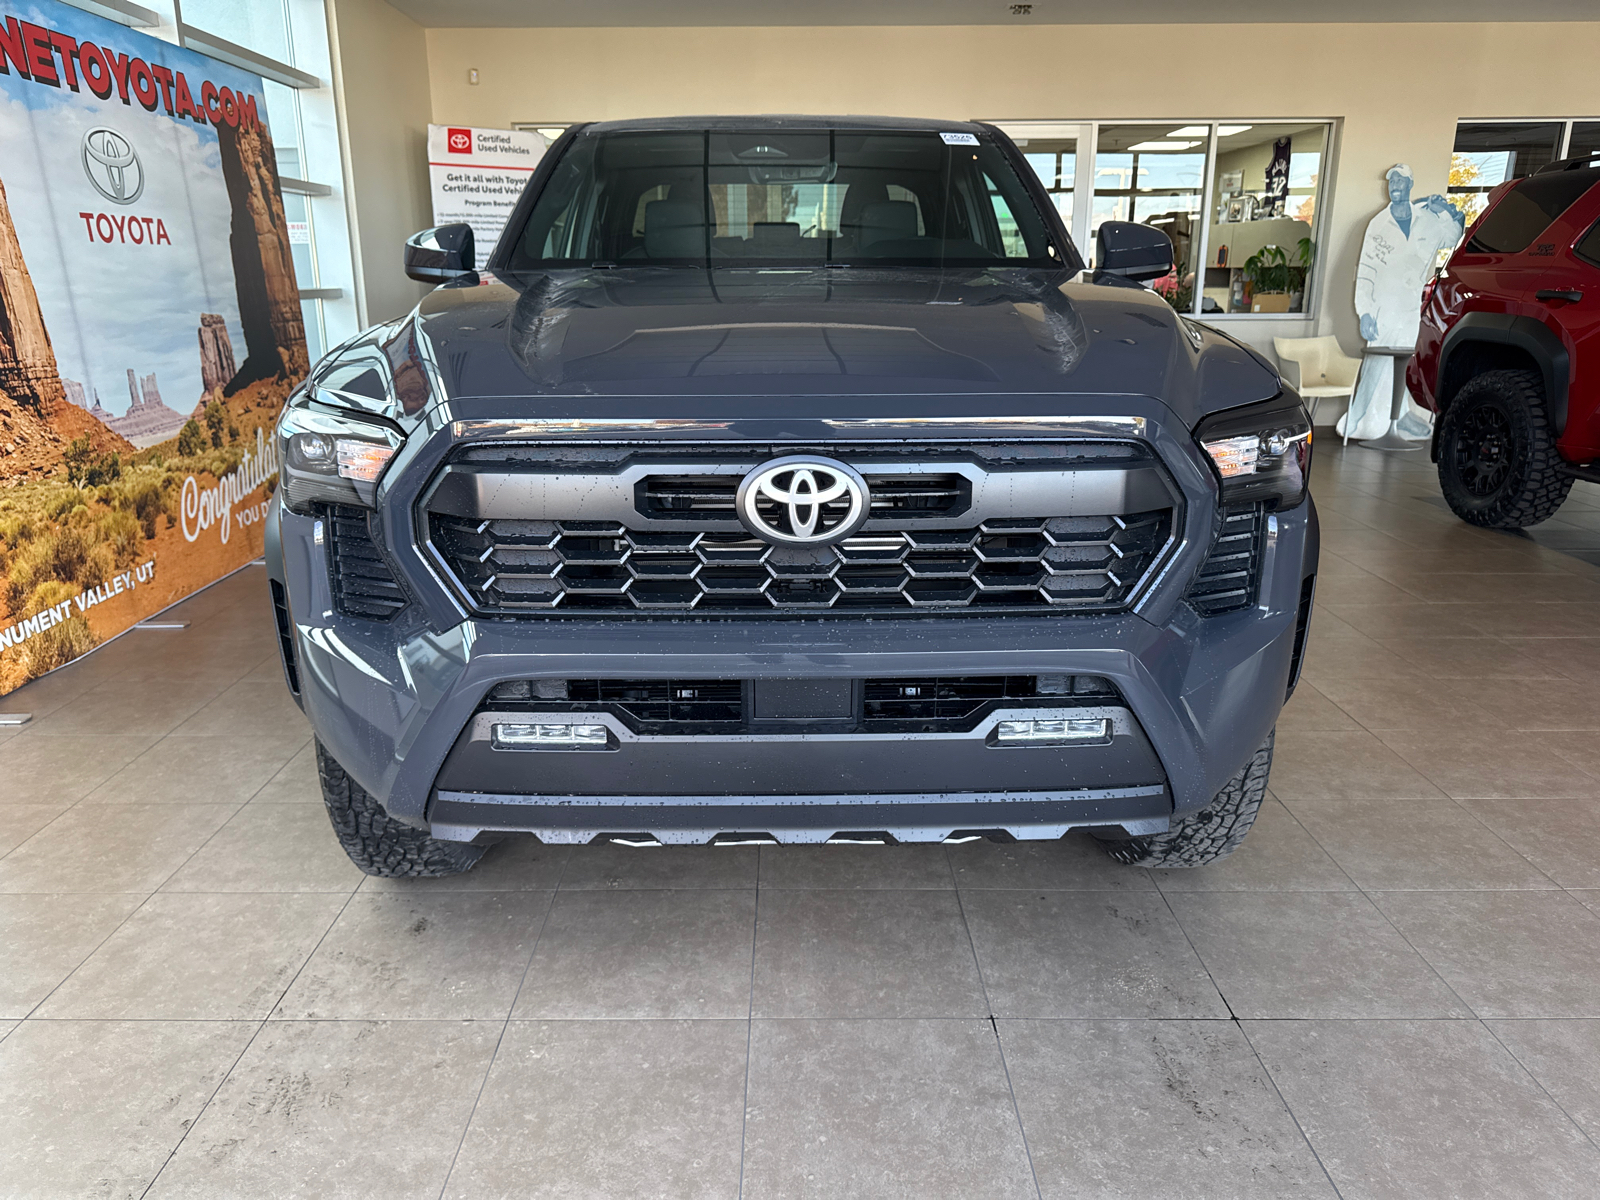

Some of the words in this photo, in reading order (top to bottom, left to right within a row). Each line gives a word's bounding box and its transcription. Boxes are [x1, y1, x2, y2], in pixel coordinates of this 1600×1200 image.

[477, 134, 511, 144] Certified
[478, 144, 498, 152] Used
[500, 145, 530, 155] Vehicles
[447, 173, 463, 182] Get
[465, 174, 471, 182] it
[473, 174, 483, 183] all
[486, 176, 504, 184] with
[506, 177, 528, 187] Toyot
[442, 184, 480, 193] Certified
[482, 186, 503, 194] Used
[504, 187, 524, 195] Vehi
[465, 199, 492, 208] Program
[79, 212, 171, 245] TOYOTA
[181, 426, 279, 544] Congratulat
[236, 505, 259, 528] YOU
[74, 571, 136, 612] VALLEY,
[136, 561, 154, 583] UT
